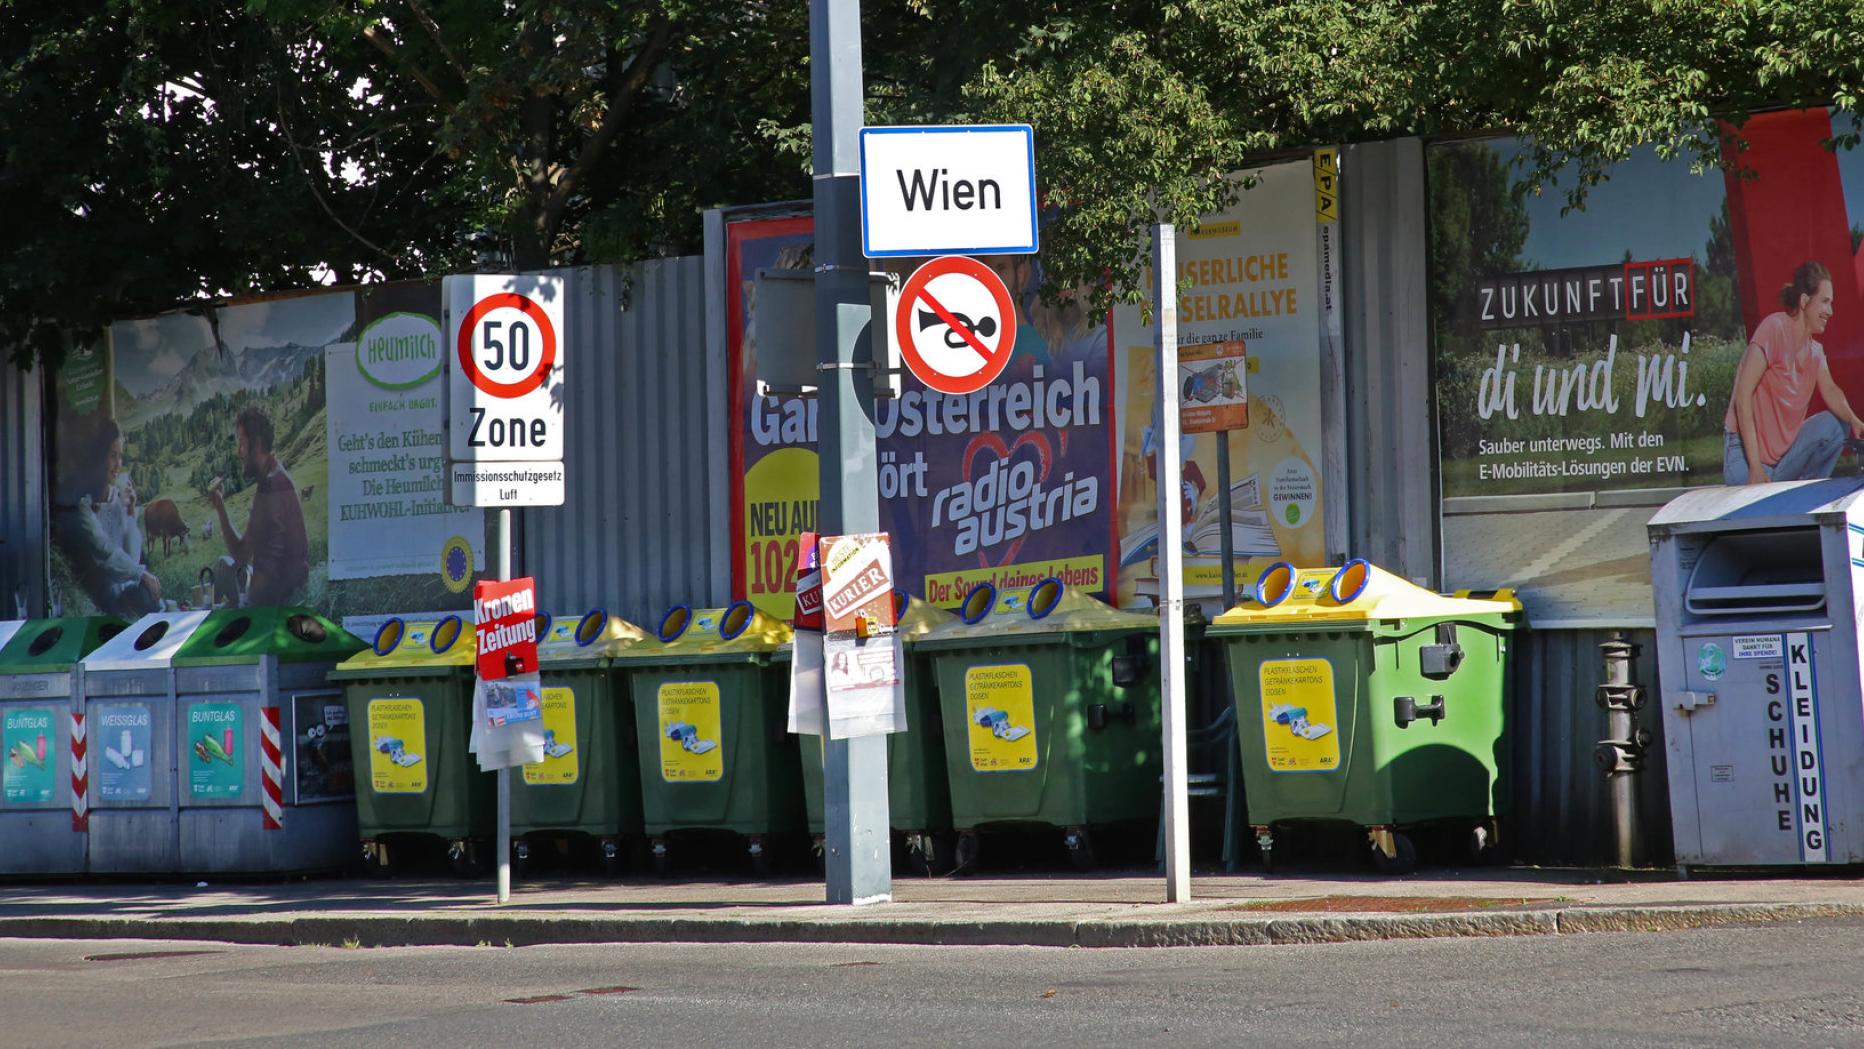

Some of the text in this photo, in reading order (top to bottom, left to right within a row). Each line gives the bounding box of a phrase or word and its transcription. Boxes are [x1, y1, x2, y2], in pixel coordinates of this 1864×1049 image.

[896, 169, 1001, 211] Wien
[1481, 267, 1688, 320] ZUKUNFT FÜR
[483, 320, 529, 371] 50
[1230, 328, 1263, 341] Familie
[1478, 344, 1521, 420] di
[1533, 334, 1620, 416] und
[338, 429, 442, 451] Geht's den Kühen
[468, 407, 546, 448] Zone
[1479, 431, 1664, 454] Sauber unterwegs. Mit den
[349, 454, 415, 475] schmeckt's
[454, 470, 561, 484] Immissionsschutzgesetz
[879, 451, 927, 499] ört
[1480, 455, 1690, 480] E-Mobilitäts-Lösungen der EVN.
[362, 480, 383, 496] Die
[500, 489, 517, 500] Luft
[932, 458, 1034, 528] radio
[751, 501, 819, 537] NEU AU
[955, 472, 1098, 556] austria
[474, 587, 534, 626] Kronen
[829, 567, 884, 610] KURIER
[929, 579, 950, 603] Der
[476, 618, 536, 656] Zeitung
[7, 717, 48, 729] BUNTGLAS
[101, 714, 148, 726] WEISSGLAS
[192, 711, 235, 722] BUNTGLAS
[1766, 674, 1791, 831] SCHUHE
[1791, 645, 1822, 850] KLEIDUNG
